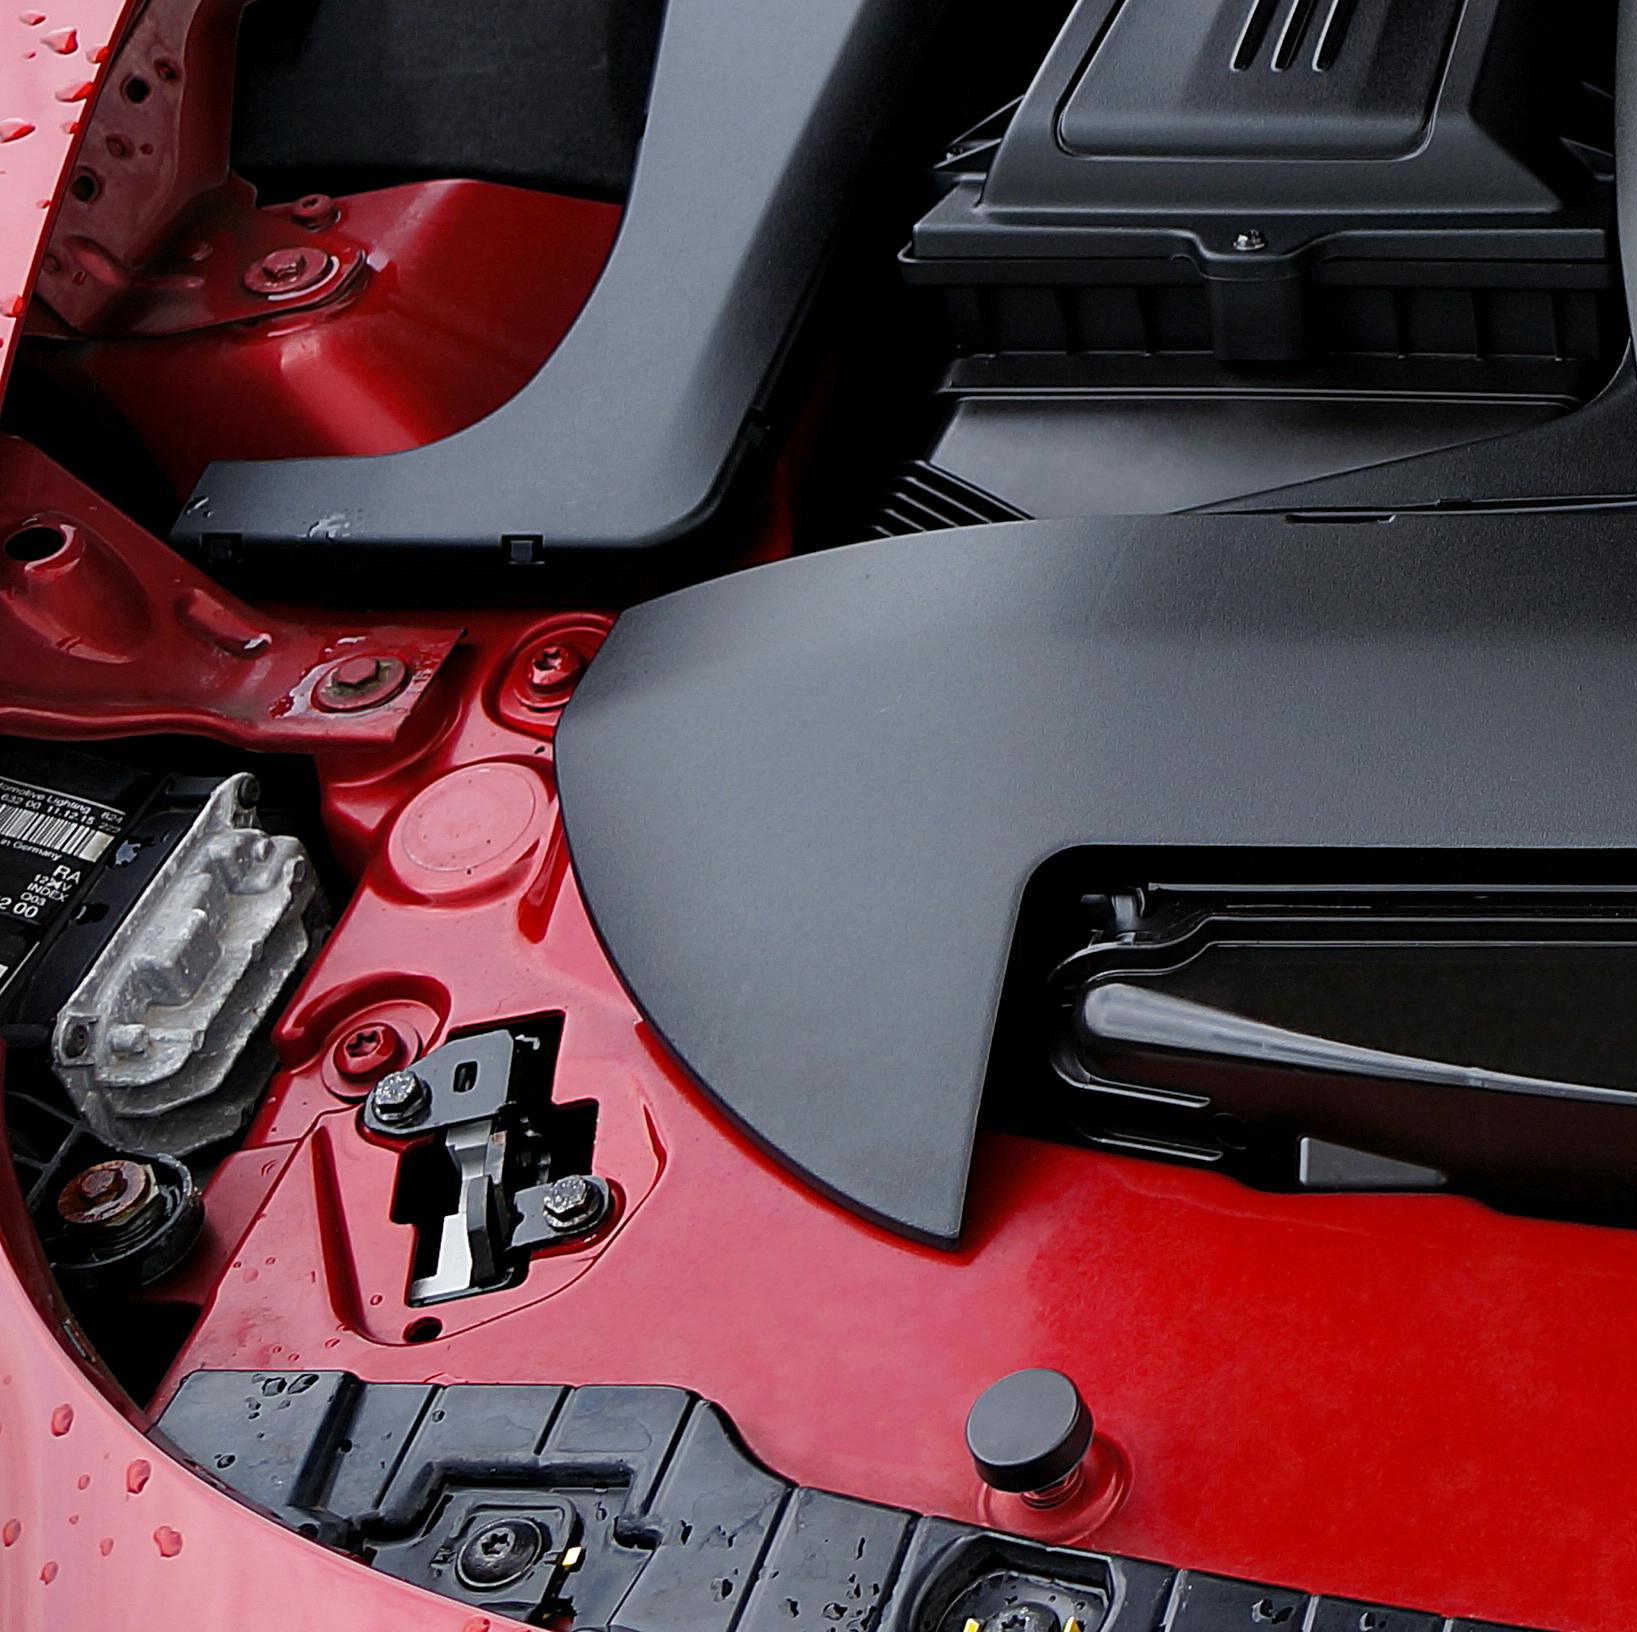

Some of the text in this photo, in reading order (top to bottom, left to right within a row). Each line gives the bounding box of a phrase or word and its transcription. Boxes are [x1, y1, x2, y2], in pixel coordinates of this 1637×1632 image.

[25, 800, 42, 810] 00
[47, 805, 96, 825] 11.12.15
[46, 794, 92, 815] Lighting
[12, 840, 63, 862] Germany
[52, 864, 82, 885] RA
[26, 882, 70, 903] INDEX
[13, 901, 39, 919] 00
